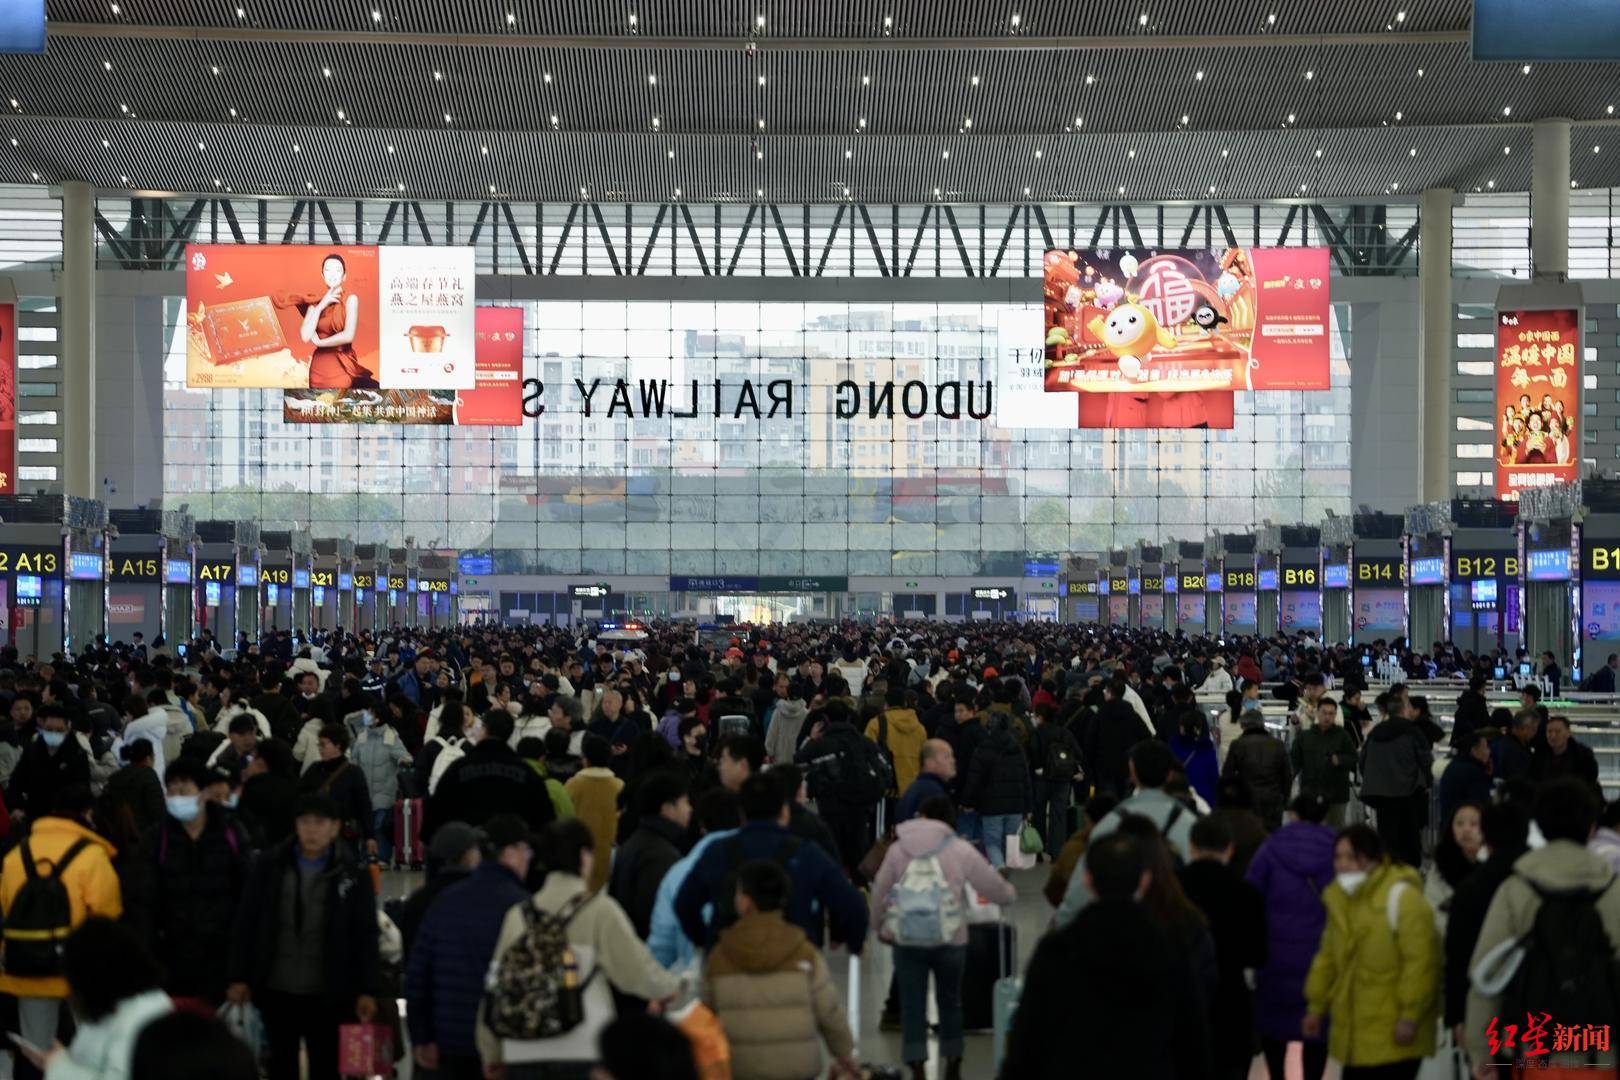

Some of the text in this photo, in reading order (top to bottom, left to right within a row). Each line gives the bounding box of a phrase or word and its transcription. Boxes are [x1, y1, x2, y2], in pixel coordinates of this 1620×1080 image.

[391, 276, 464, 290] 高端春节礼
[391, 293, 464, 307] 燕之屋燕窝
[1501, 343, 1575, 367] 温暖中国
[1510, 367, 1568, 389] 每一面
[15, 552, 57, 572] A13
[1457, 557, 1496, 577] B12
[1592, 547, 1620, 571] B1
[121, 559, 157, 576] A15
[200, 564, 232, 580] A17
[1358, 563, 1392, 580] B14
[260, 569, 289, 583] A19
[311, 572, 333, 586] A21
[1227, 572, 1254, 587] B18
[1284, 568, 1316, 585] B16
[430, 581, 448, 592] A26
[1112, 580, 1127, 591] B2
